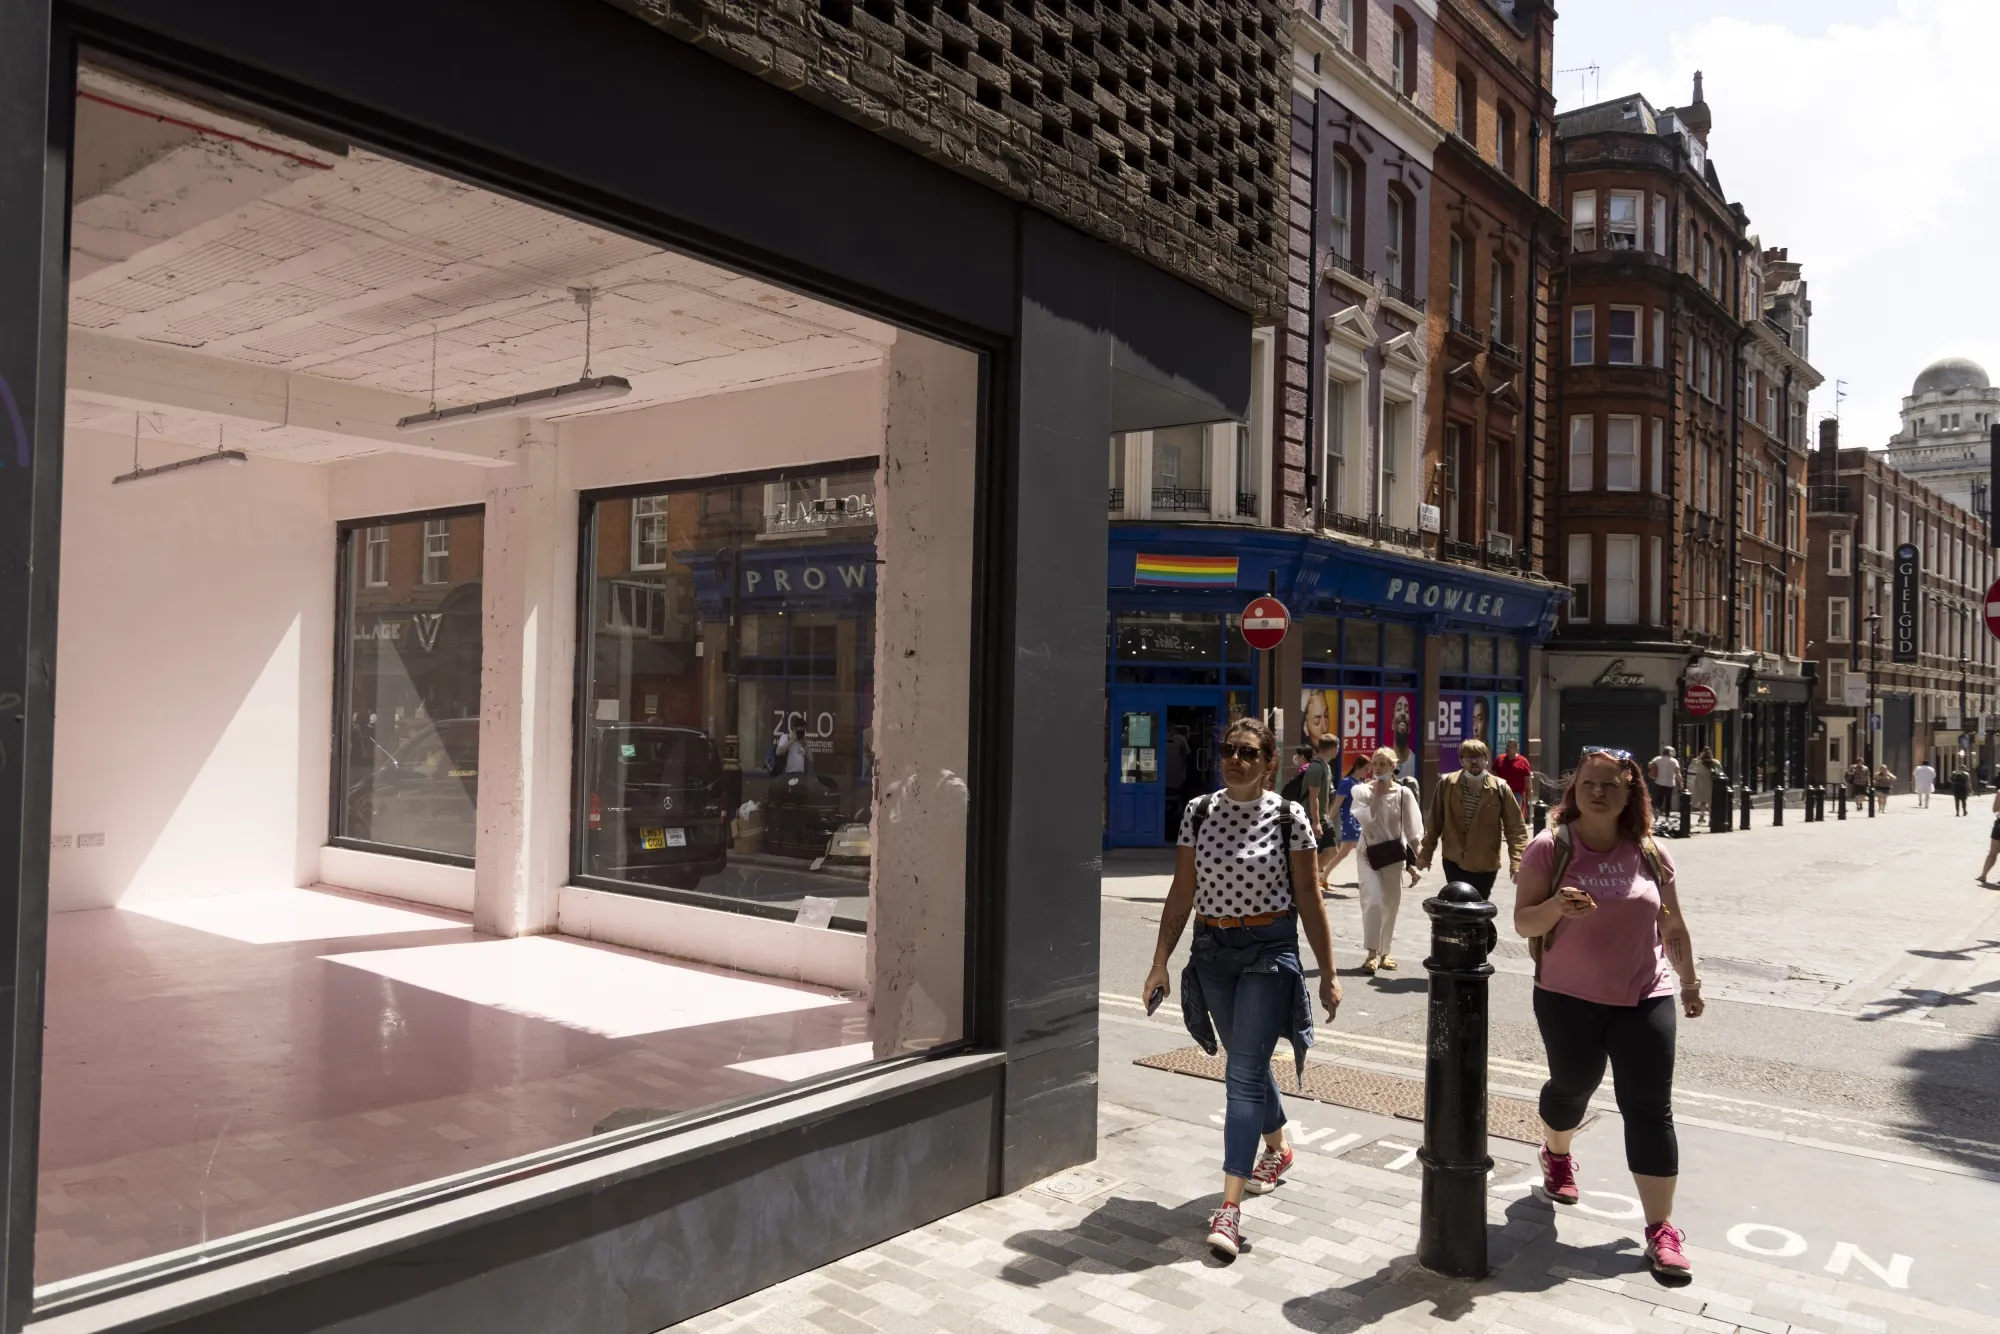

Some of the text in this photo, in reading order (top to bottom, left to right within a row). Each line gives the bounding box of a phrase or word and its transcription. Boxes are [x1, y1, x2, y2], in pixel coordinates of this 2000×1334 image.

[1386, 577, 1504, 617] PROWLER
[1898, 562, 1913, 653] GIELGUD
[1344, 698, 1376, 737] BE
[1438, 701, 1462, 735] BE
[1497, 702, 1520, 734] BE
[1343, 738, 1375, 749] FREE
[1497, 734, 1519, 743] PROD
[1577, 871, 1647, 887] Yourse
[1597, 862, 1625, 874] Put
[1726, 1222, 1914, 1290] NO
